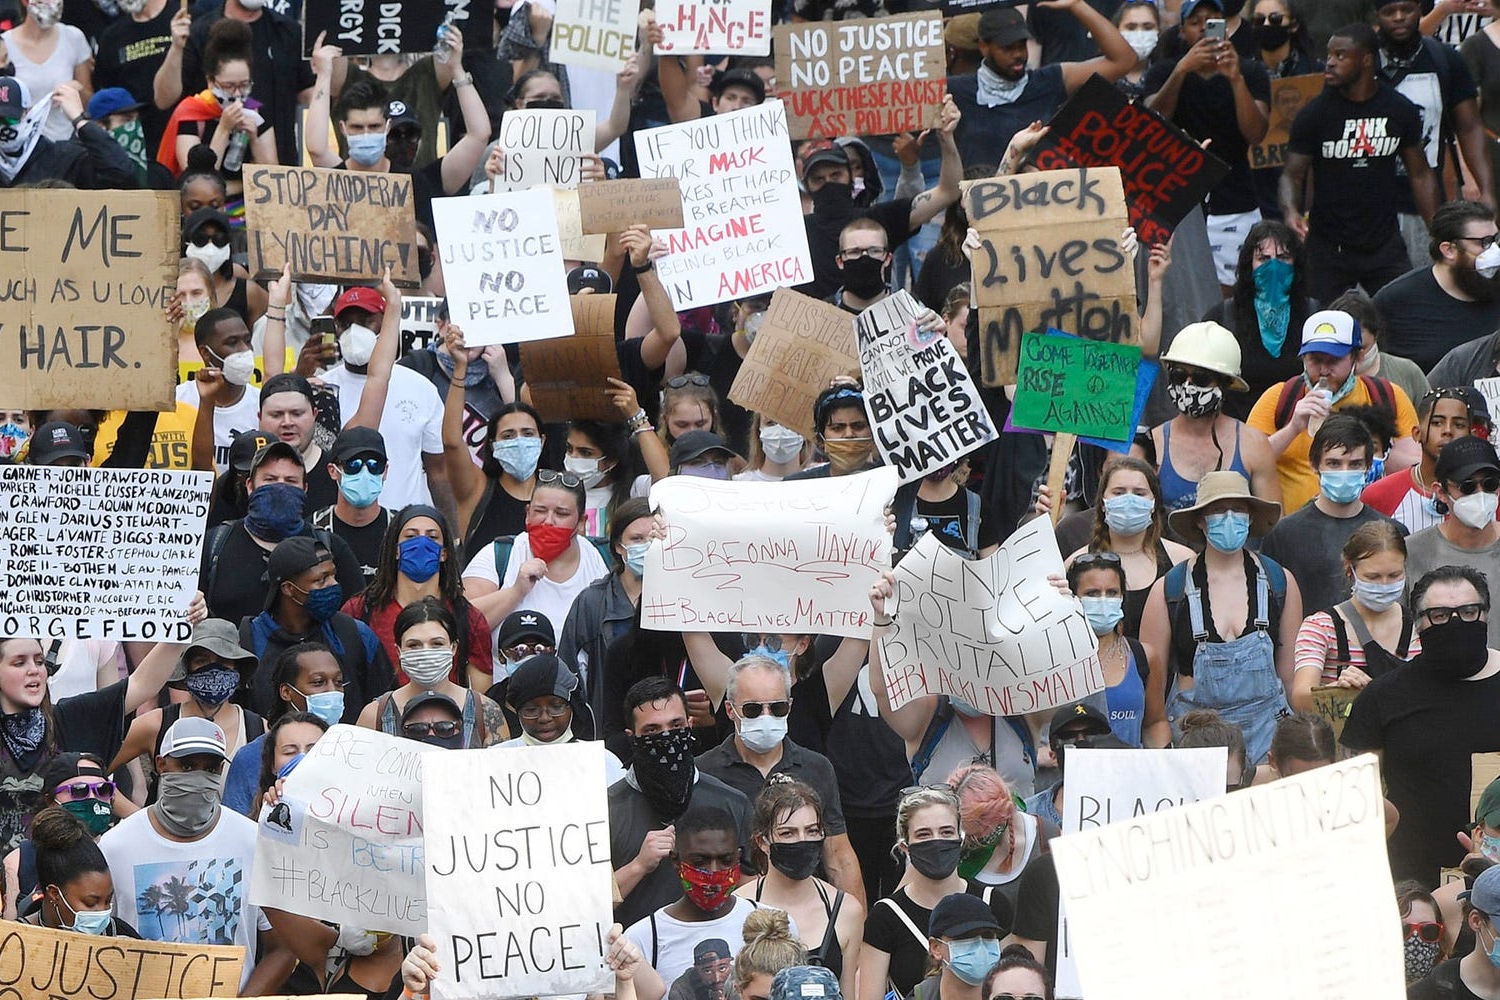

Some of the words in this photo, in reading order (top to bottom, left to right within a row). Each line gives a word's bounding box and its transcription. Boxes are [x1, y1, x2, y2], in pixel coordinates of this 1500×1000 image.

[377, 3, 403, 54] DICK
[555, 24, 634, 60] POLICE
[655, 3, 765, 51] CHANGE
[790, 28, 828, 59] NO
[839, 20, 942, 51] JUSTICE
[791, 58, 830, 88] NO
[839, 51, 929, 83] PEACE
[505, 114, 584, 152] COLOR
[647, 132, 671, 161] IF
[681, 123, 722, 149] YOU
[727, 107, 789, 138] THINK
[809, 112, 846, 137] ASS
[856, 105, 924, 134] POLICE!
[1114, 104, 1203, 175] DEFUND
[504, 156, 523, 184] IS
[645, 158, 695, 180] YOUR
[709, 147, 767, 174] MASK
[745, 169, 791, 189] HARD
[253, 169, 317, 204] STOP
[326, 173, 408, 208] MODERN
[692, 189, 780, 220] BREATHE
[970, 167, 1106, 221] Black
[62, 205, 143, 267] ME
[308, 203, 350, 232] DAY
[472, 208, 519, 234] NO
[256, 236, 411, 276] LYNCHING!
[445, 235, 555, 265] JUSTICE
[659, 253, 716, 276] BEING
[723, 235, 782, 260] BLACK
[982, 238, 1124, 288] Lives
[51, 278, 80, 302] AS
[93, 280, 112, 302] U
[120, 284, 177, 309] LOVE
[479, 270, 525, 294] NO
[717, 256, 804, 298] AMERICA
[469, 294, 550, 320] PEACE
[20, 324, 142, 373] HAIR.
[861, 334, 908, 366] CANNOT
[912, 339, 949, 371] PROVE
[1025, 335, 1076, 366] COME
[870, 357, 967, 424] BLACK
[1023, 366, 1066, 398] RISE
[875, 387, 972, 451] LIVES
[1043, 400, 1129, 427] AGAINST
[890, 410, 991, 479] MATTER
[7, 559, 36, 572] ROSE
[663, 523, 799, 571] BREONNA
[816, 522, 882, 568] TAYLOR
[103, 620, 192, 640] FLOYD
[897, 578, 1053, 646] POLICE
[881, 609, 1097, 681] BRUTALITY
[366, 785, 414, 804] WHEN
[488, 770, 542, 809] NO
[303, 829, 329, 850] IS
[432, 821, 612, 876] JUSTICE
[495, 880, 545, 918] NO
[451, 922, 606, 983] PEACE!
